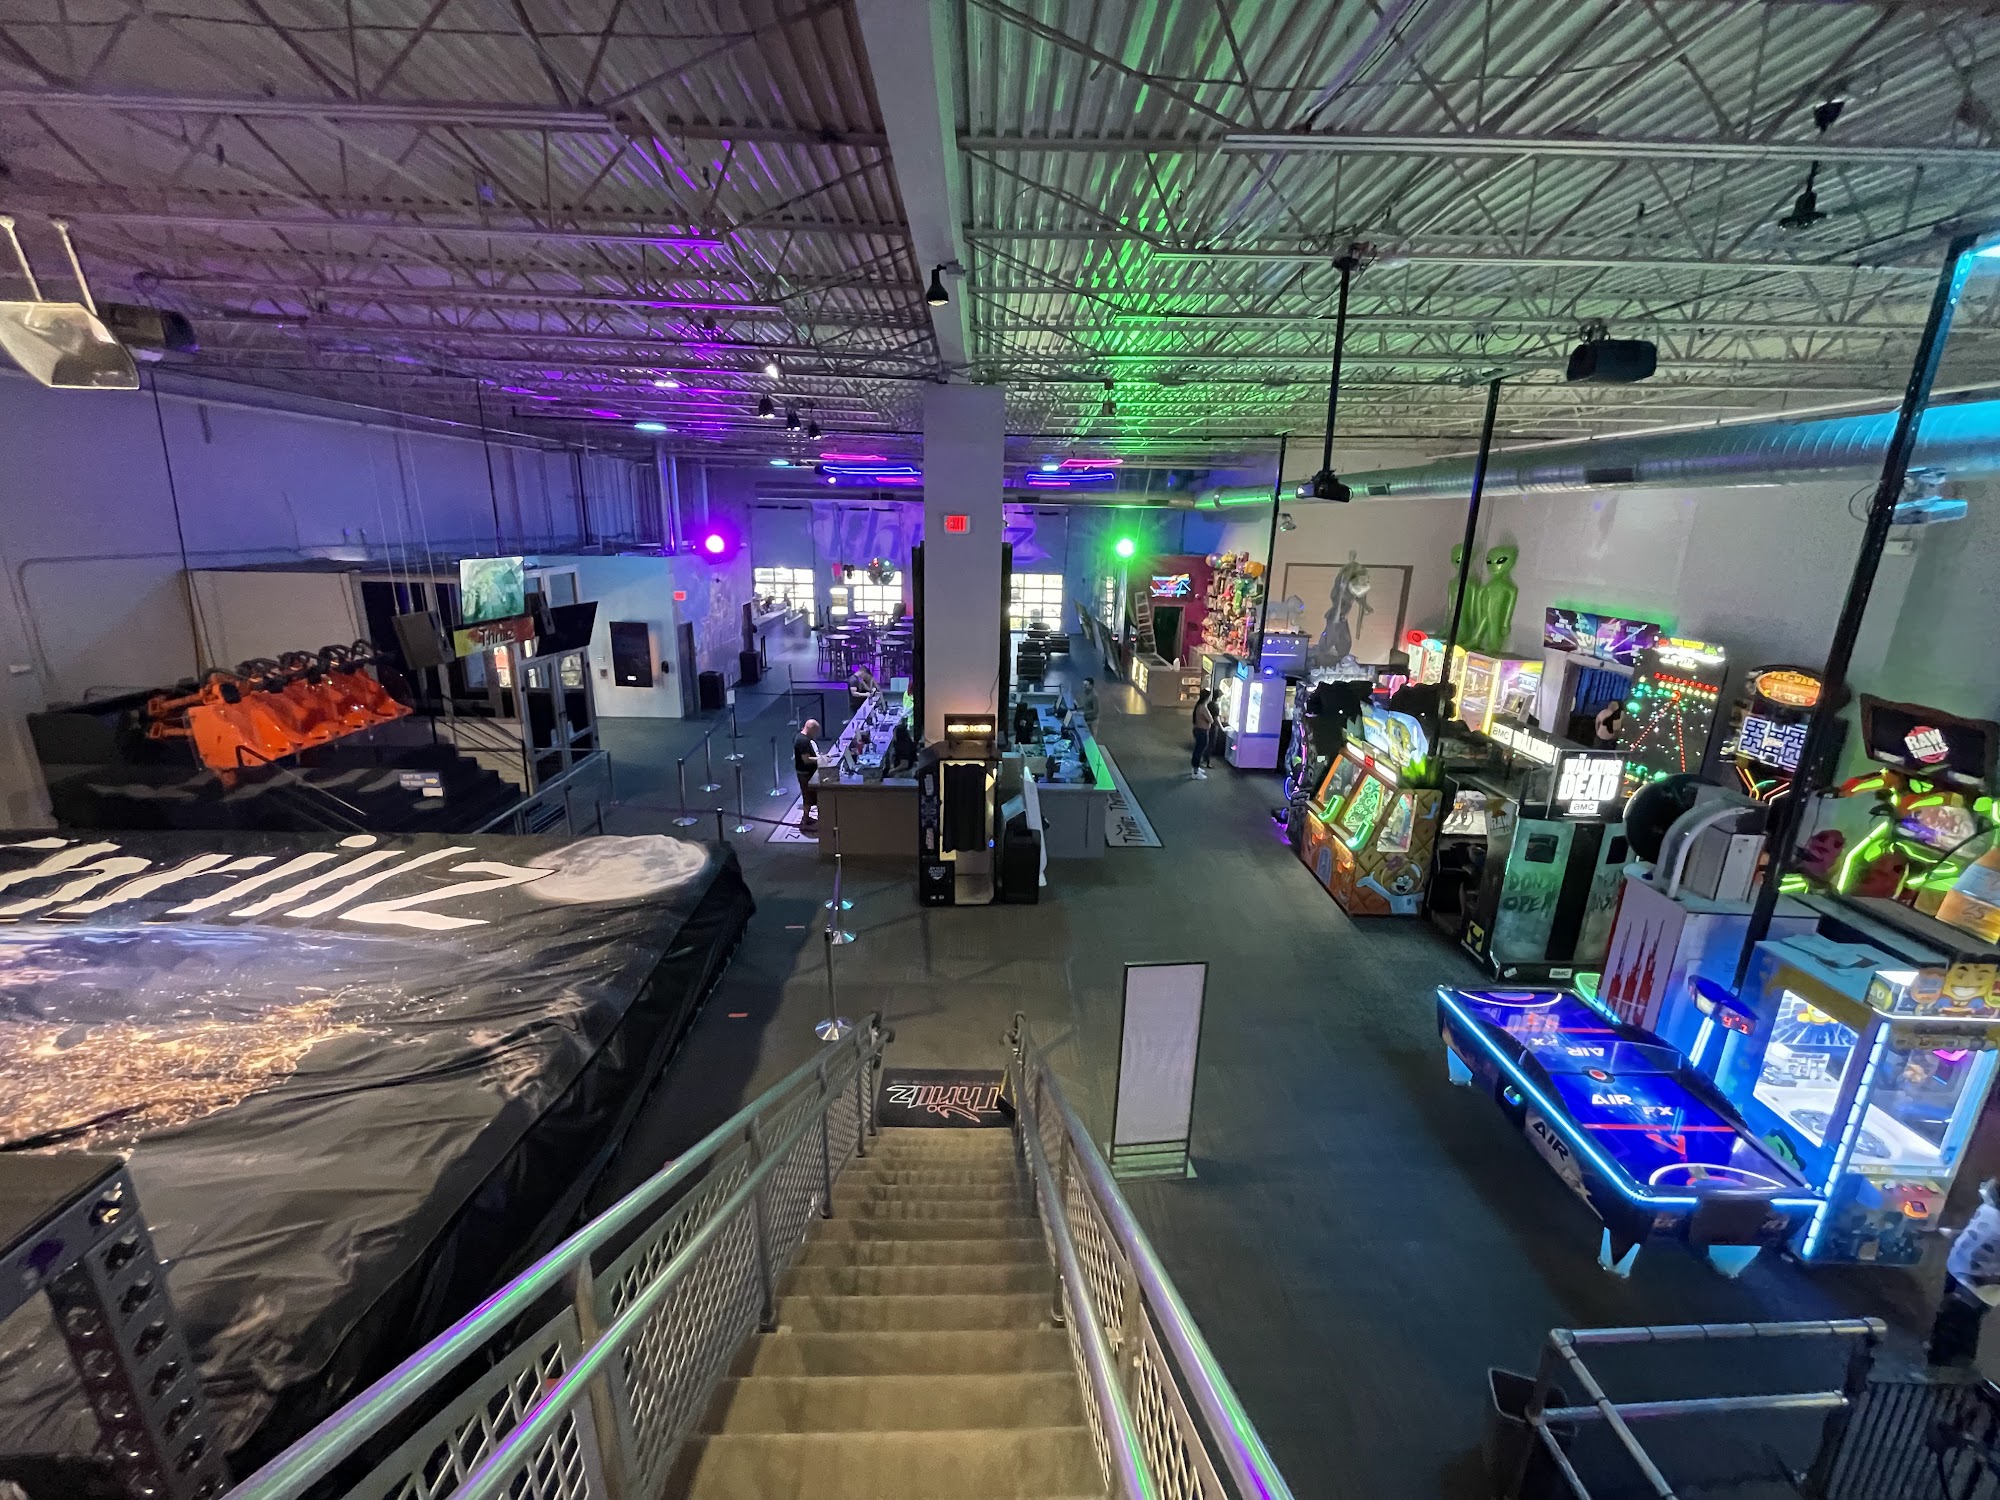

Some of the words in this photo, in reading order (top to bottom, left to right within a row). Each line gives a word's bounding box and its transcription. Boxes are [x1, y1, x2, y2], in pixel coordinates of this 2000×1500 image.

[949, 516, 967, 531] EXIT
[1904, 728, 1943, 751] RAW
[1563, 758, 1623, 776] WALKING
[1557, 773, 1619, 801] DEAD
[1490, 815, 1513, 831] RAW
[1502, 890, 1557, 914] OPEN
[1565, 1046, 1606, 1057] AIR
[886, 1084, 1002, 1113] Thrillz
[1592, 1094, 1635, 1106] AIR
[1642, 1106, 1674, 1117] FX
[1533, 1120, 1570, 1162] AIR
